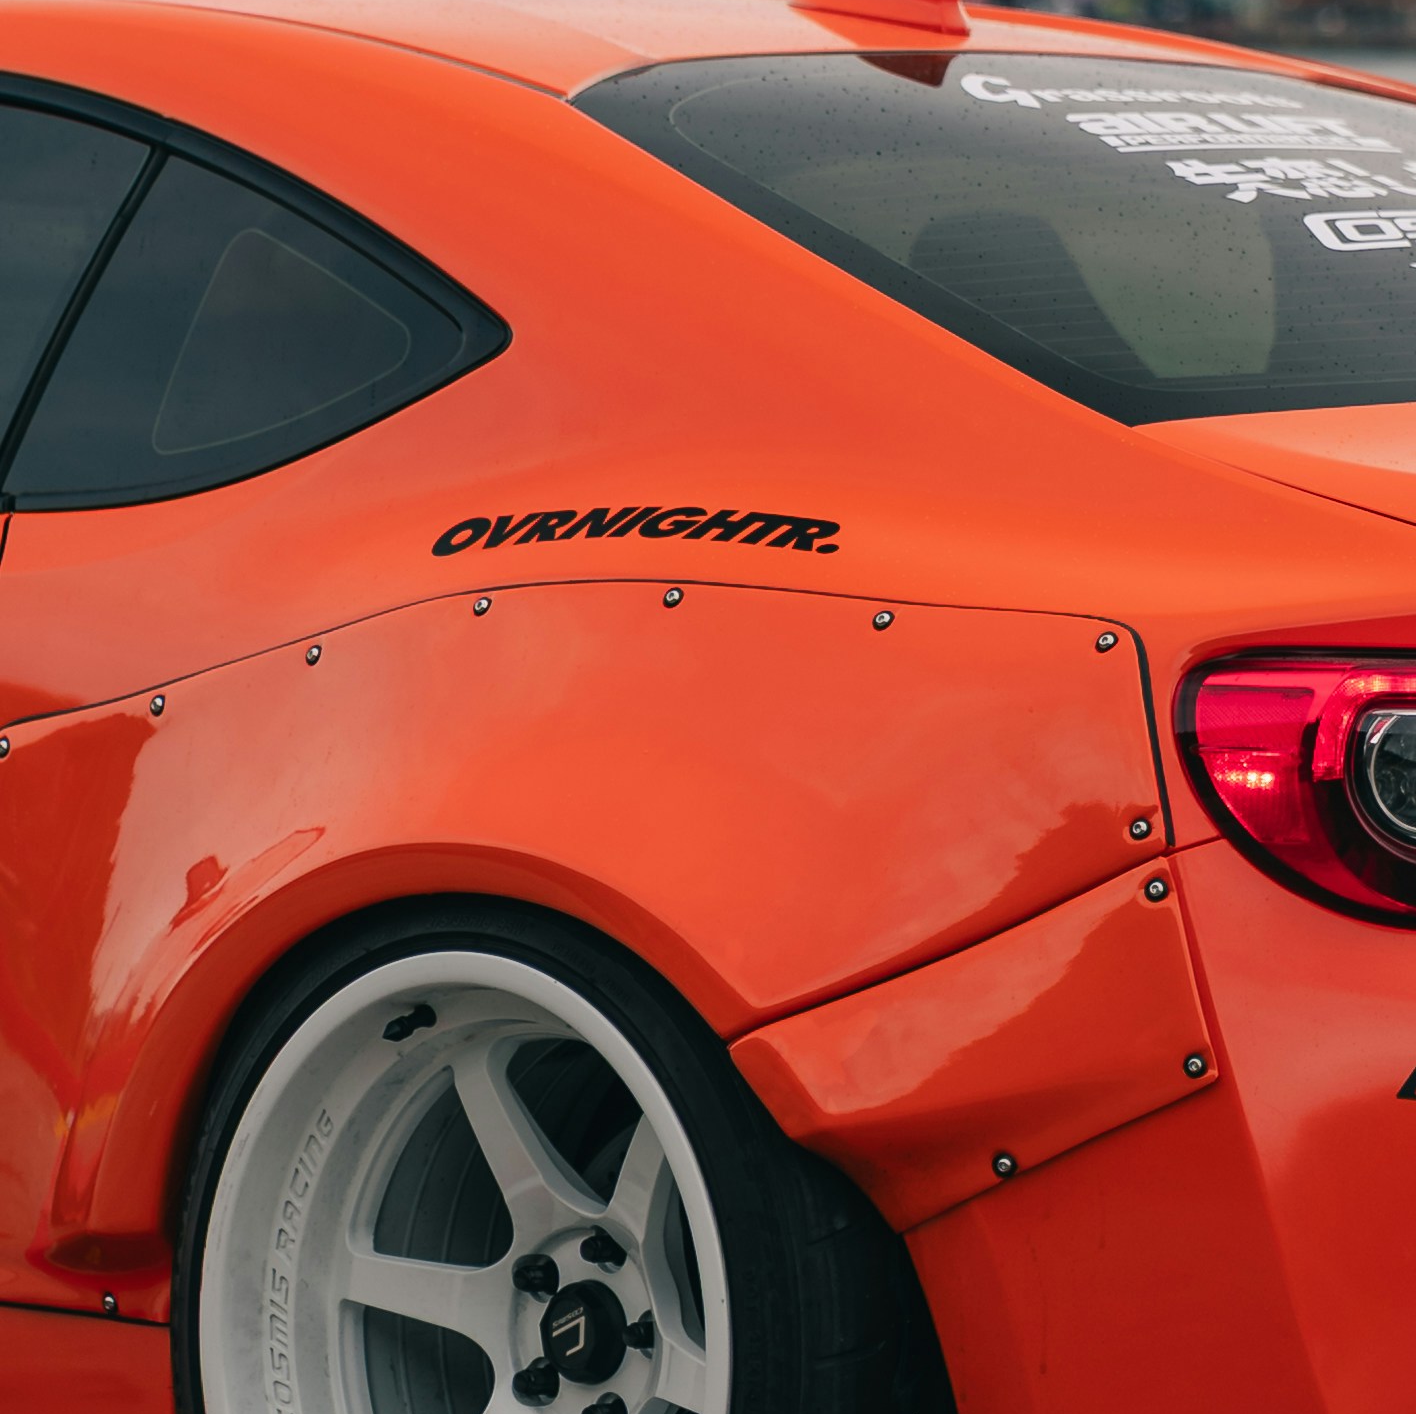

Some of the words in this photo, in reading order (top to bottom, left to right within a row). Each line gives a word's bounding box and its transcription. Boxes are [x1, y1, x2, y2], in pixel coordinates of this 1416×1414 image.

[960, 73, 1303, 109] Grassroots
[1205, 112, 1358, 137] LIFT
[431, 506, 840, 557] OVRNIGHTR.
[274, 1107, 335, 1265] RACING
